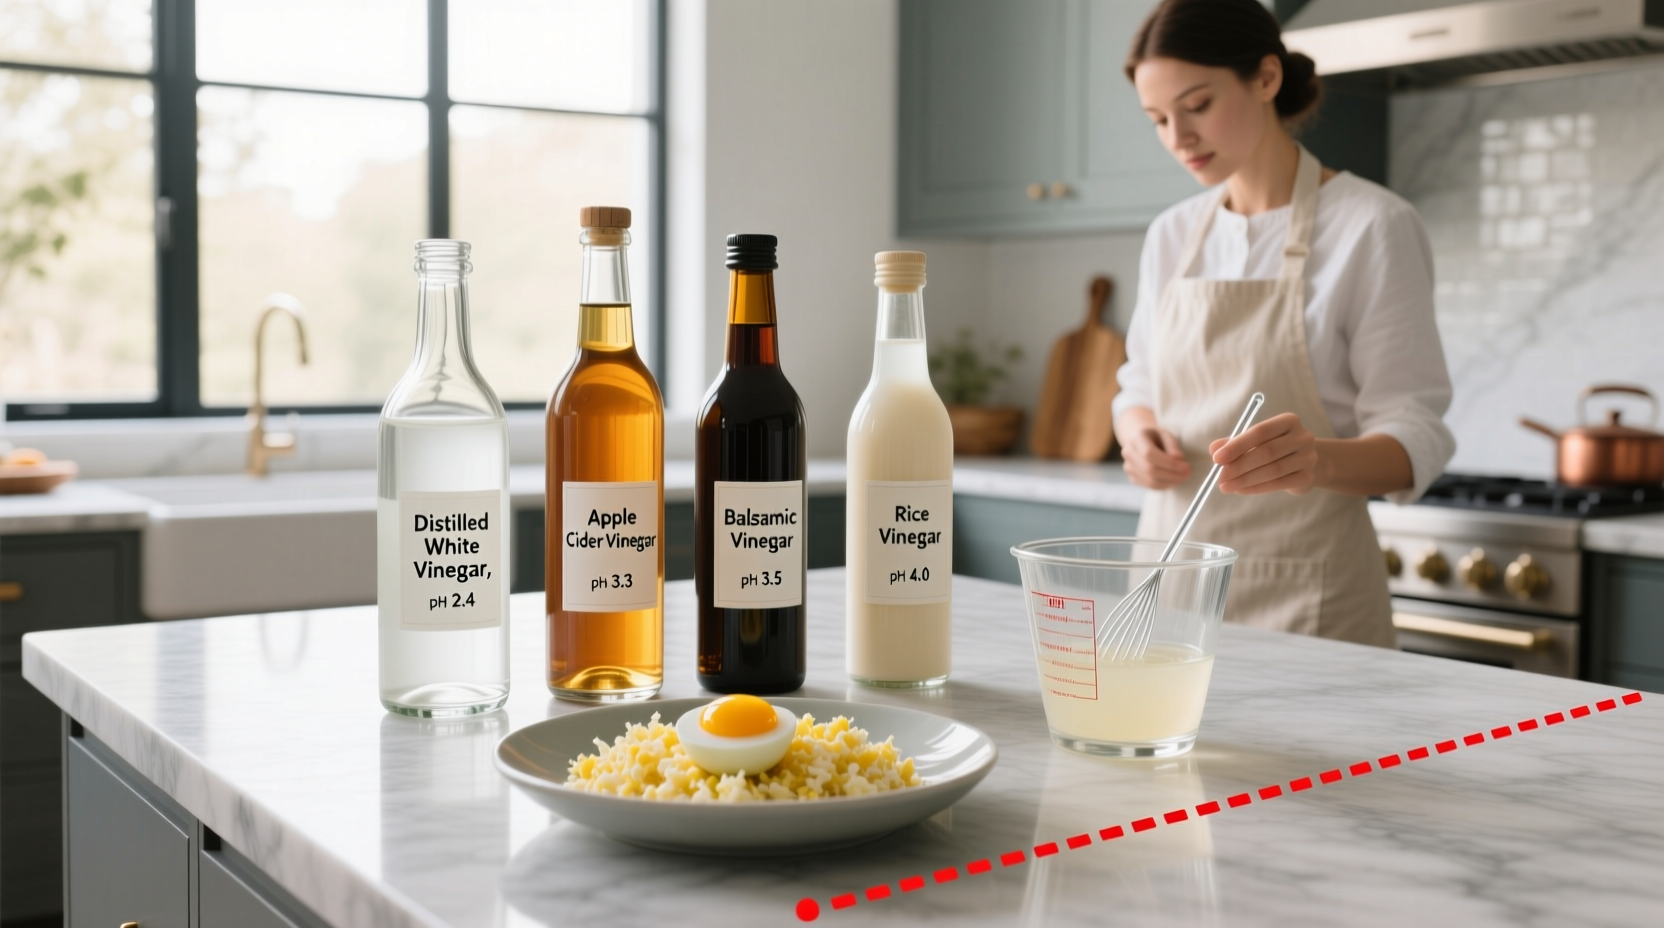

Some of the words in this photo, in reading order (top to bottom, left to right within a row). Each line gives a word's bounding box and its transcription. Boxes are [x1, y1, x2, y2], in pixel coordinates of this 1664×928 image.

[414, 511, 489, 532] Distilled
[587, 507, 637, 529] Apple
[724, 507, 797, 527] Balsamic
[895, 504, 930, 522] Rice
[424, 537, 480, 555] White
[566, 531, 603, 549] Cider
[605, 533, 657, 552] Vinegar
[730, 531, 794, 553] Vinegar
[878, 527, 942, 549] Vinegar
[413, 560, 492, 583] Vinegar,
[741, 573, 758, 589] pH
[761, 570, 782, 586] 3.5
[889, 569, 906, 585] pH
[909, 566, 930, 582] 4.0
[591, 576, 608, 592] pH
[611, 573, 633, 589] 3.3
[429, 595, 447, 611] pH
[451, 592, 476, 608] 2.4
